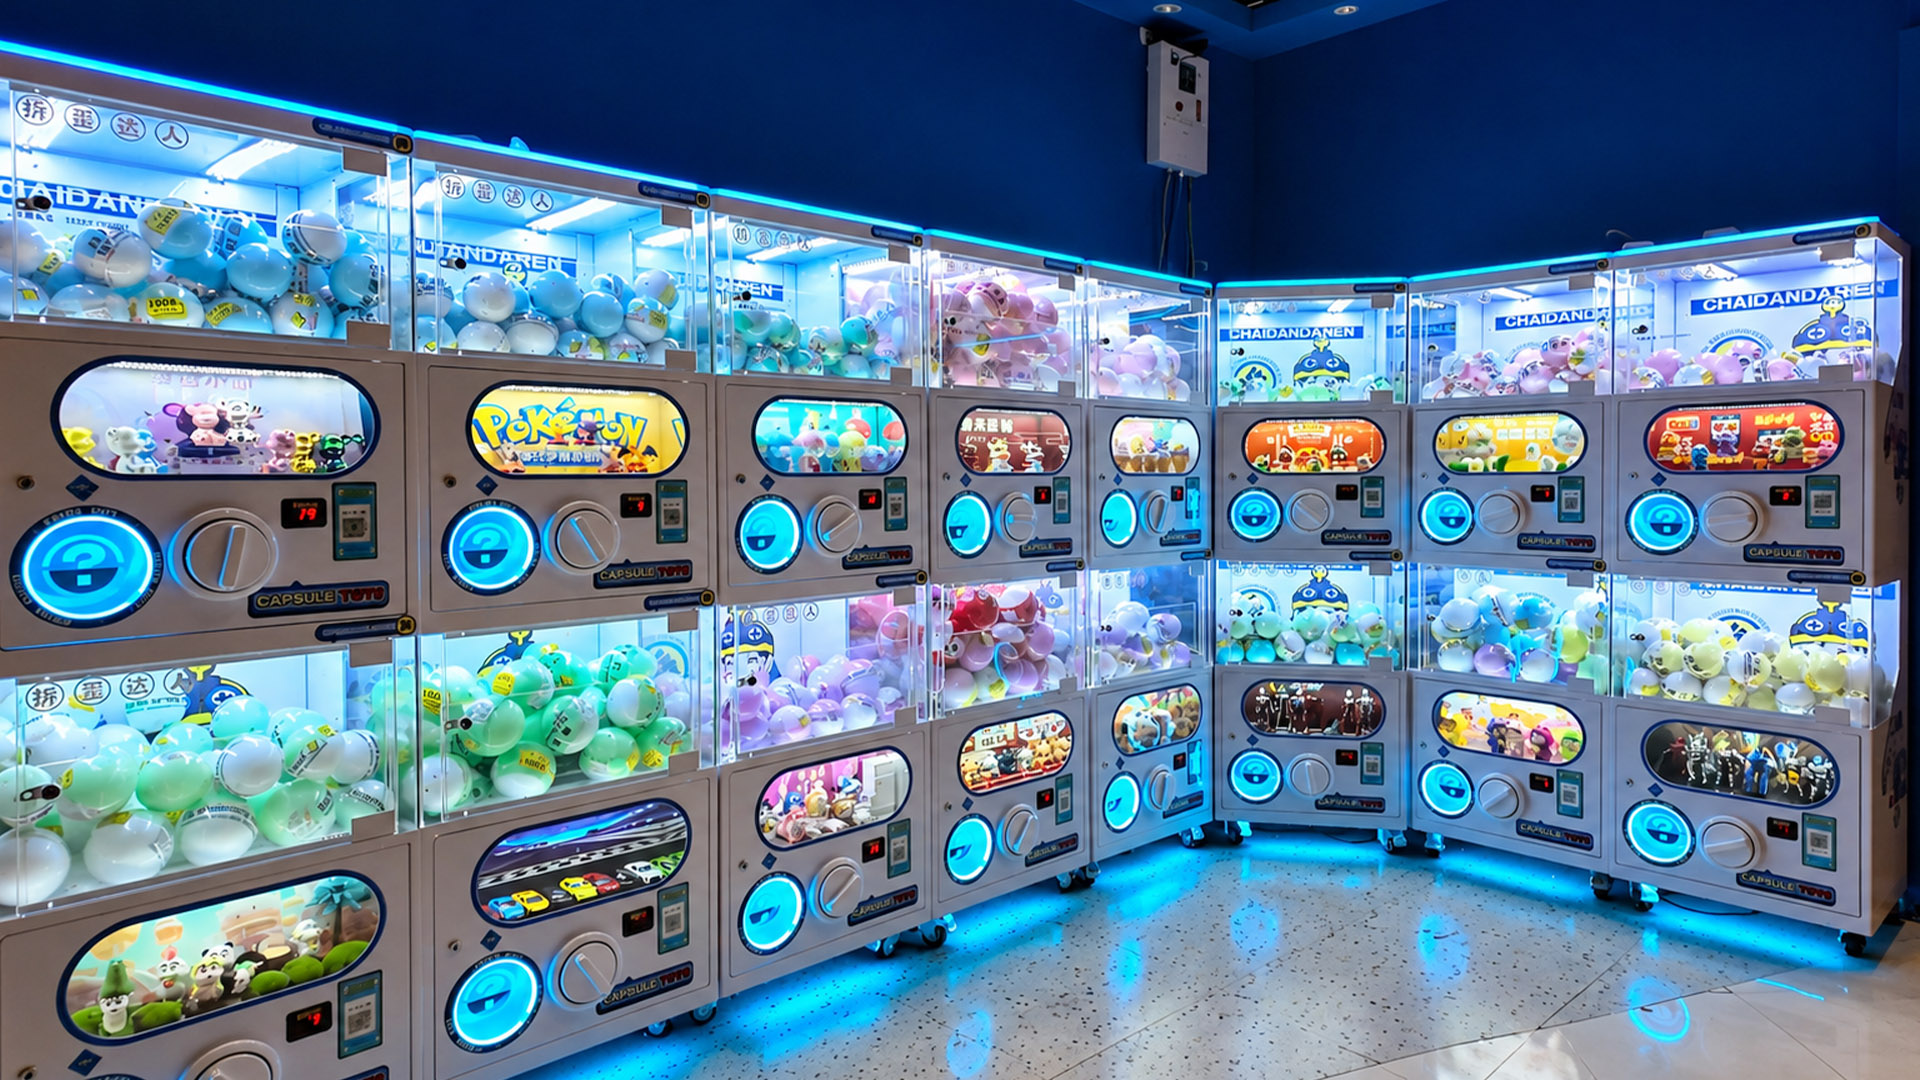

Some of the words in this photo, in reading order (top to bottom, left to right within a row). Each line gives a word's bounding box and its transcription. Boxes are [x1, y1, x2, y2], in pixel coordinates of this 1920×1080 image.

[1749, 547, 1802, 558] CAPSULE
[256, 590, 336, 608] CAPSULE
[1741, 872, 1796, 891] CAPSULE
